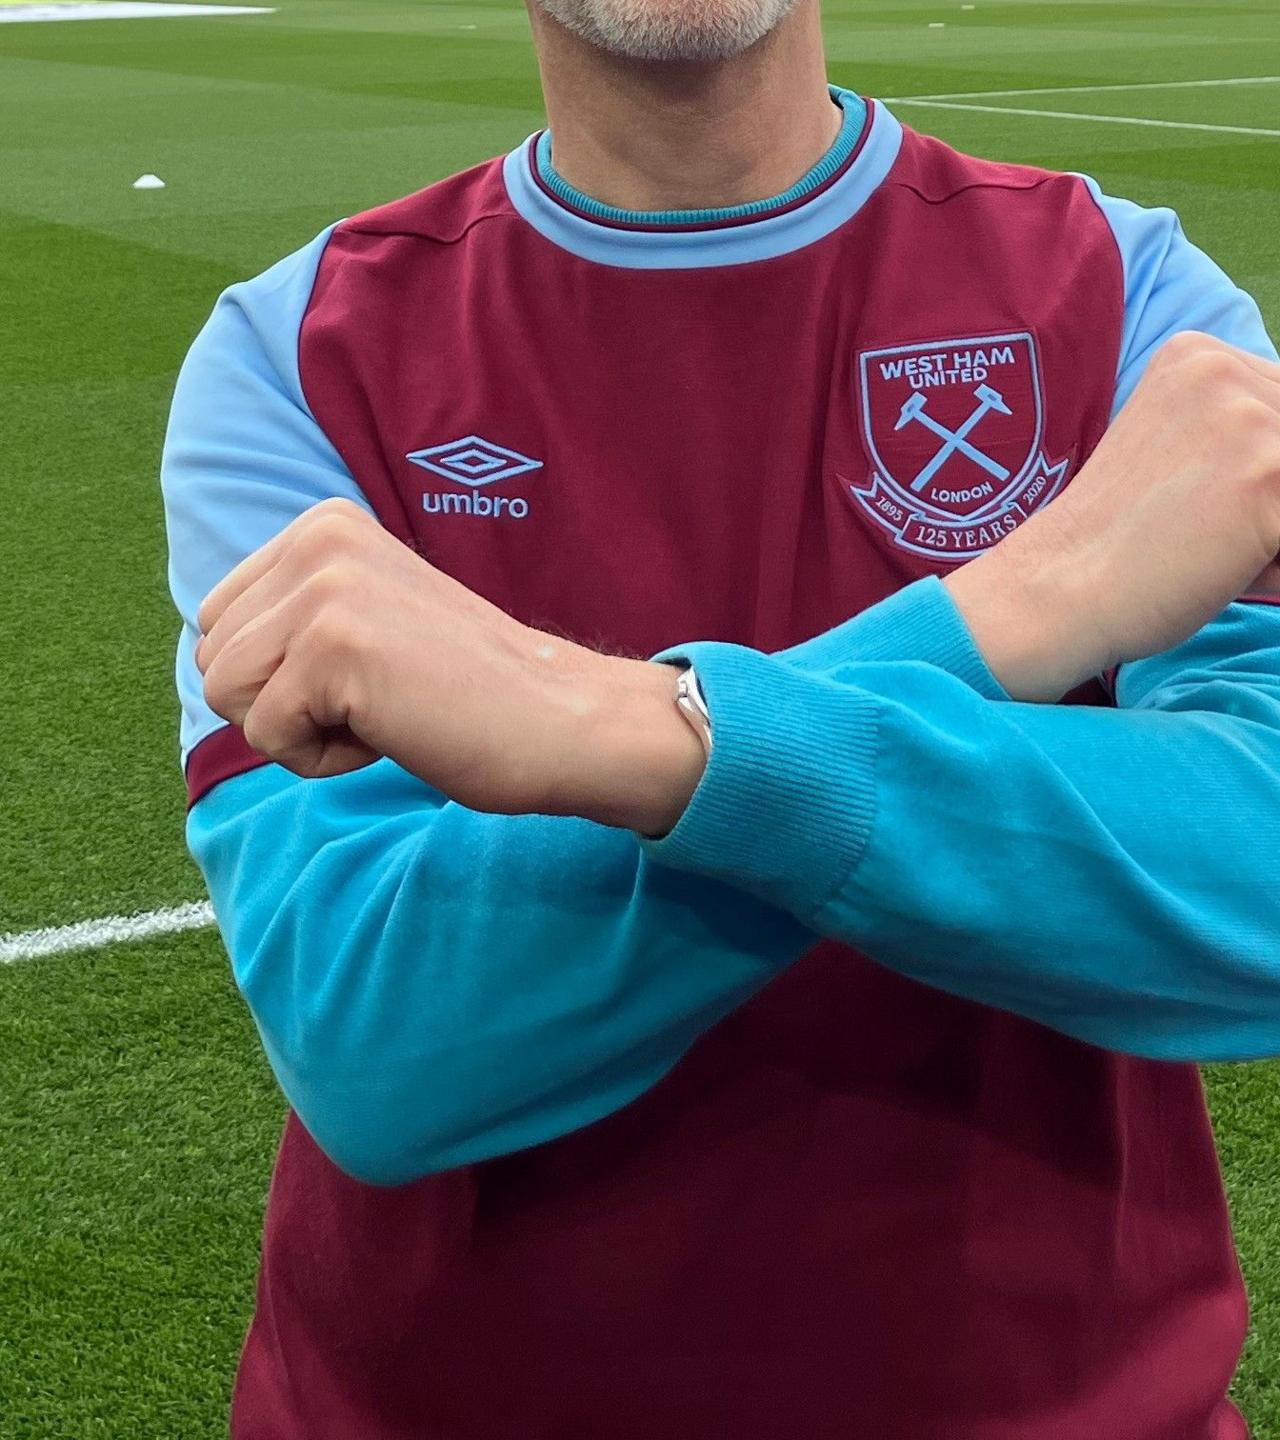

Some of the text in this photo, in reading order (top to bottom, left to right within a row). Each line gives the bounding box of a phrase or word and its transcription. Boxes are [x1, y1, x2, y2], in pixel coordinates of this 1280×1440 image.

[879, 346, 1015, 381] WEST HAM
[909, 367, 988, 389] UNITED
[422, 489, 529, 519] umbro
[931, 481, 994, 503] LONDON
[875, 475, 1047, 548] 1895 125 YEARS 2020
